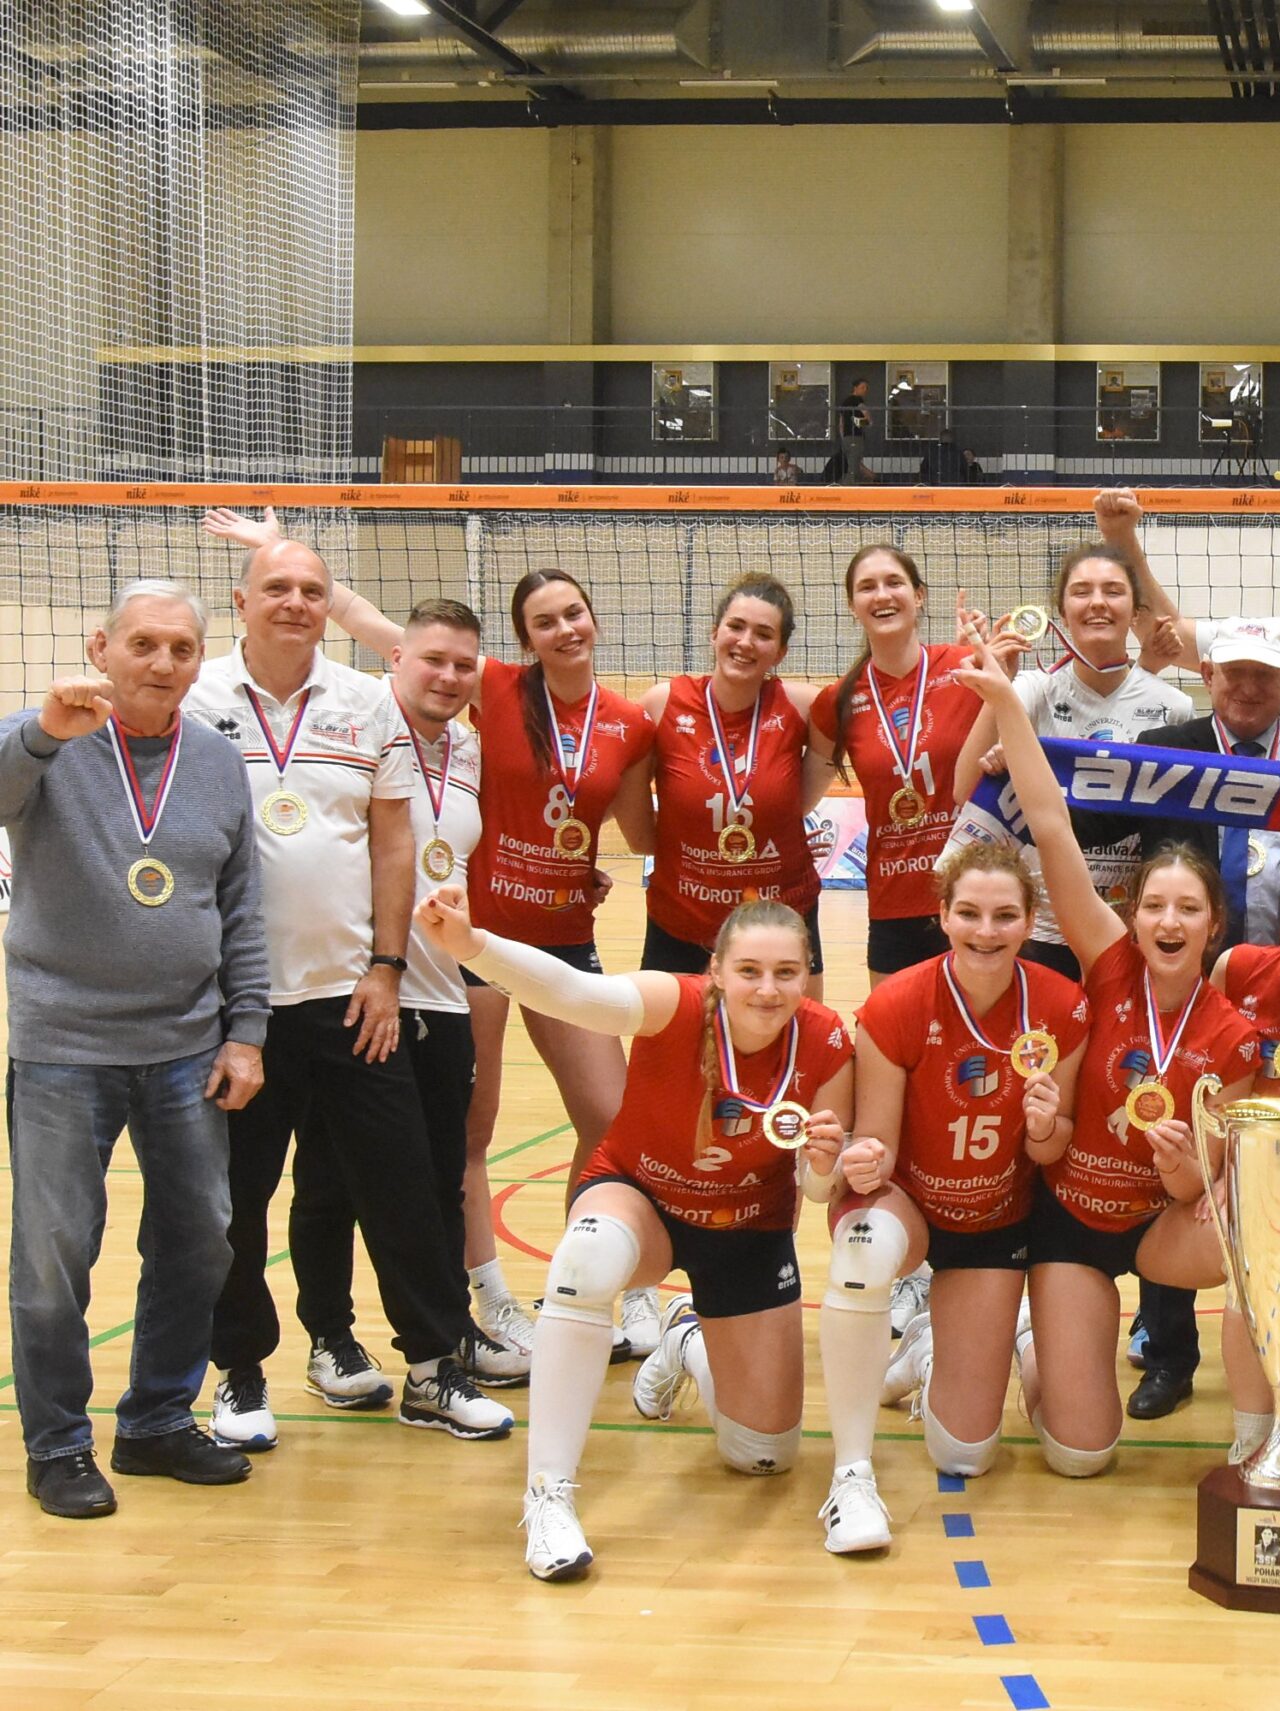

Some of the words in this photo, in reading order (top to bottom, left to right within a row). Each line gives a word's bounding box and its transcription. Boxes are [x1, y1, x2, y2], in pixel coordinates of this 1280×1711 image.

[20, 486, 40, 498] niké
[126, 487, 146, 499] niké
[340, 489, 361, 501] niké
[449, 490, 470, 502] niké
[558, 491, 580, 503] niké
[668, 491, 689, 503] niké
[779, 491, 801, 504] niké
[1004, 493, 1026, 505] niké
[1232, 493, 1254, 506] niké
[543, 783, 569, 829] 8
[705, 792, 754, 833] 16
[526, 865, 568, 877] INSURANCE
[706, 868, 753, 877] INSURANCE
[754, 865, 782, 875] GROUP
[948, 1115, 1002, 1161] 15
[692, 1146, 733, 1172] 2
[910, 1161, 999, 1190] Kooperativa
[848, 1236, 873, 1244] errea
[778, 1276, 797, 1290] errea
